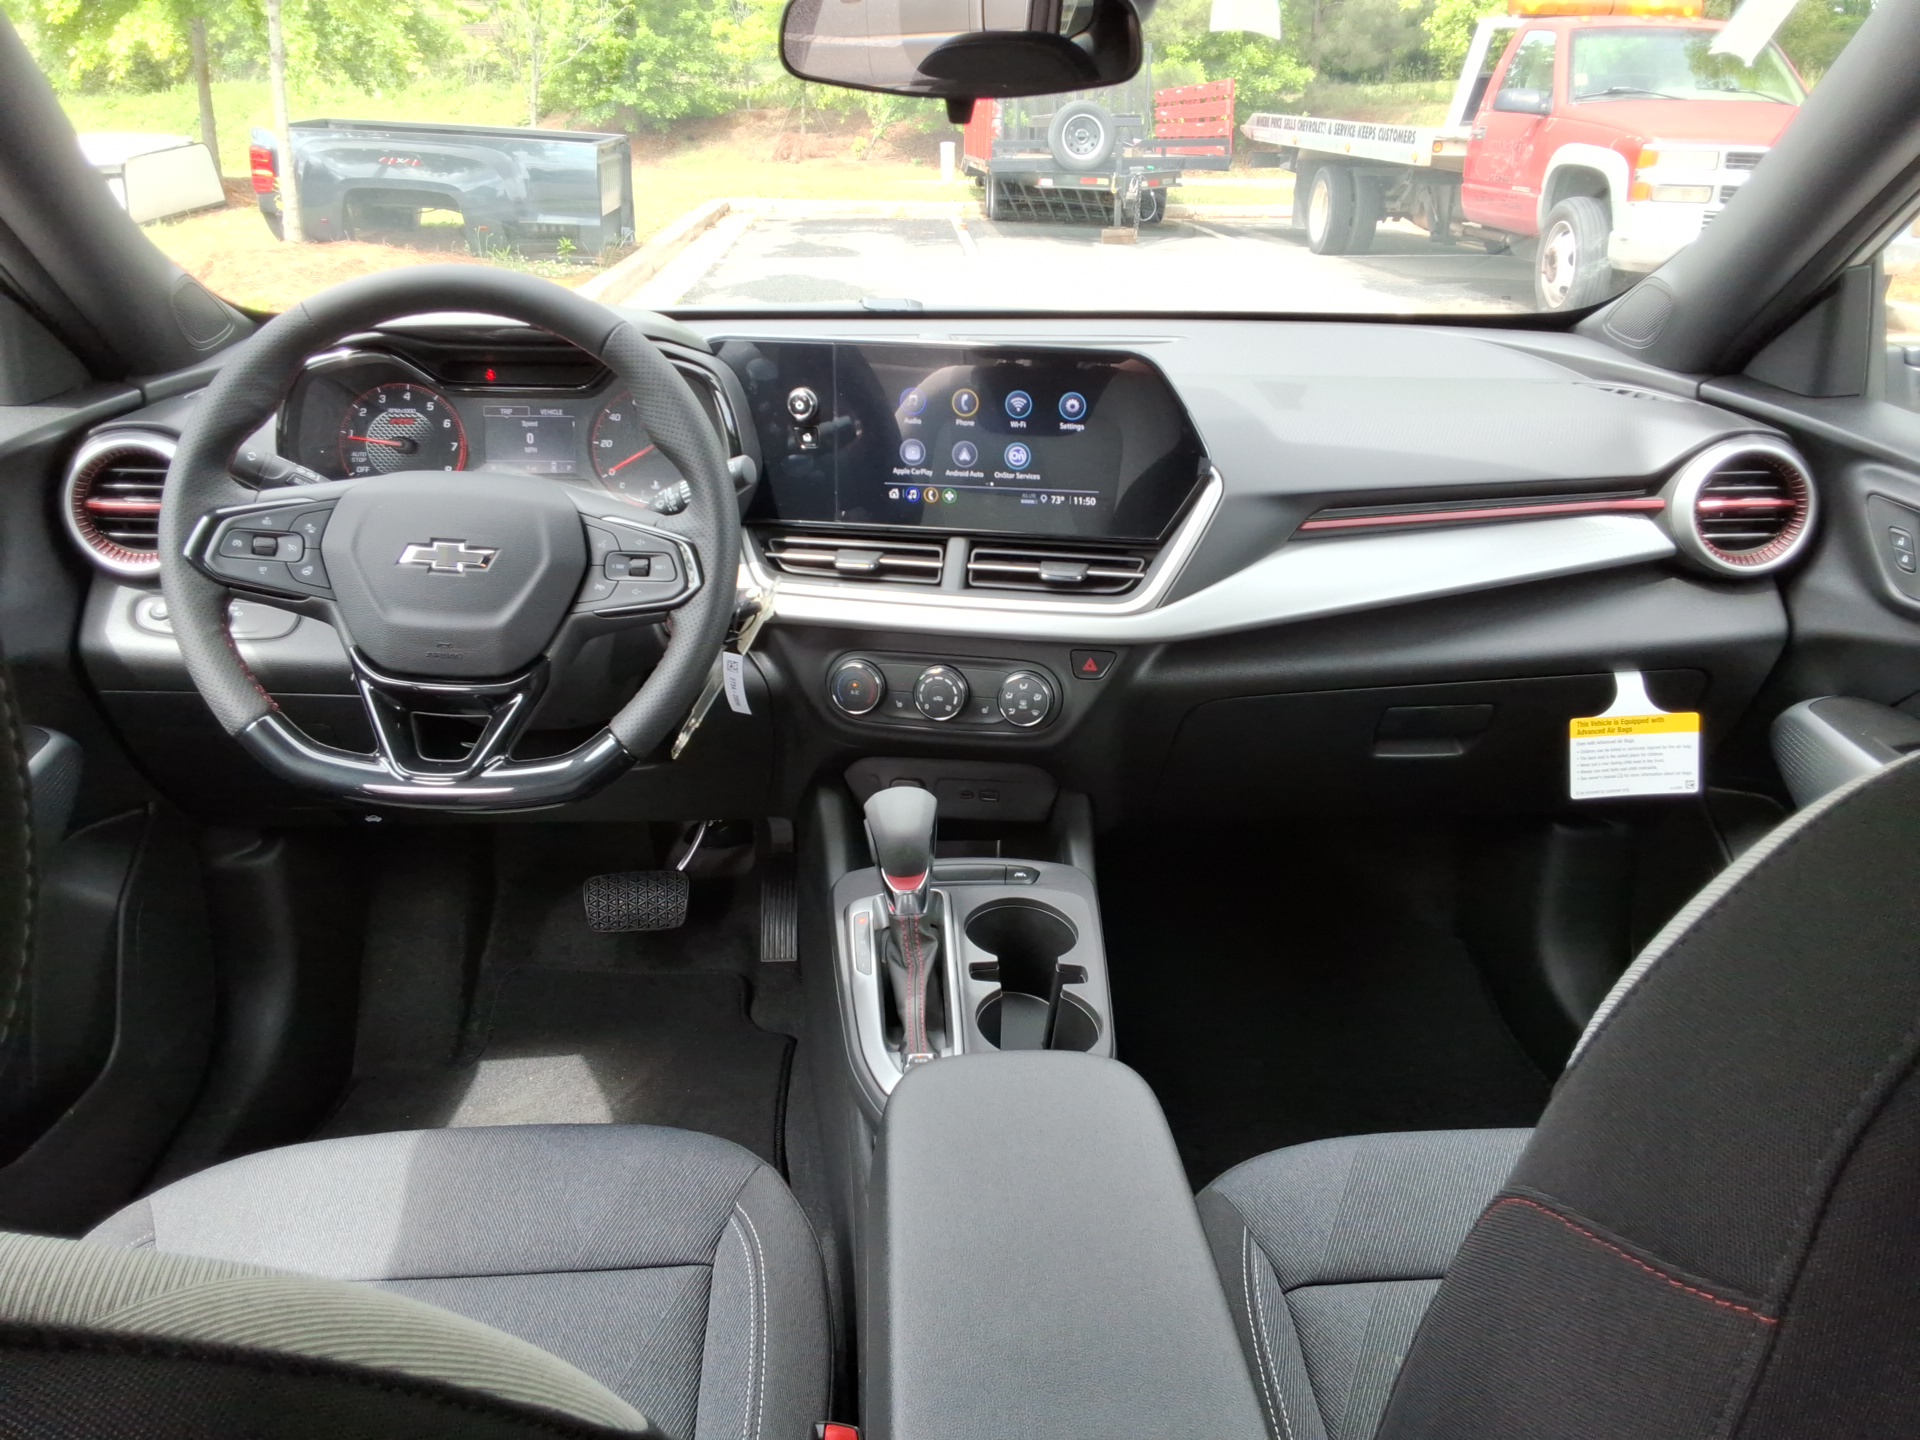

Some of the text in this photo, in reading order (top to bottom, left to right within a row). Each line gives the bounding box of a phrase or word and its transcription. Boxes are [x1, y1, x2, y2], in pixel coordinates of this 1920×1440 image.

[1270, 117, 1283, 128] PRICE
[1283, 118, 1296, 130] SELLS
[1333, 125, 1356, 138] SERVICE
[1356, 126, 1377, 140] KEEPS
[1377, 128, 1417, 144] CUSTOMERS
[378, 394, 386, 403] 3
[403, 392, 411, 401] 4
[426, 402, 434, 411] 5
[359, 408, 367, 416] 2
[540, 408, 563, 416] VEHICLE
[609, 413, 621, 422] 40
[904, 417, 922, 425] Audio
[443, 419, 451, 428] 6
[956, 419, 975, 427] Phone
[1010, 421, 1027, 429] Wi-Fi
[1059, 422, 1085, 432] Settings
[526, 432, 534, 444] 0
[451, 442, 458, 451] 7
[600, 439, 613, 448] 20
[893, 467, 933, 477] Apple CarPlay
[994, 472, 1040, 480] OnStar Services
[1073, 496, 1097, 506] 11:50
[1590, 719, 1612, 727] Vehicle
[1620, 718, 1650, 726] Equipped
[1576, 728, 1606, 736] Advanced
